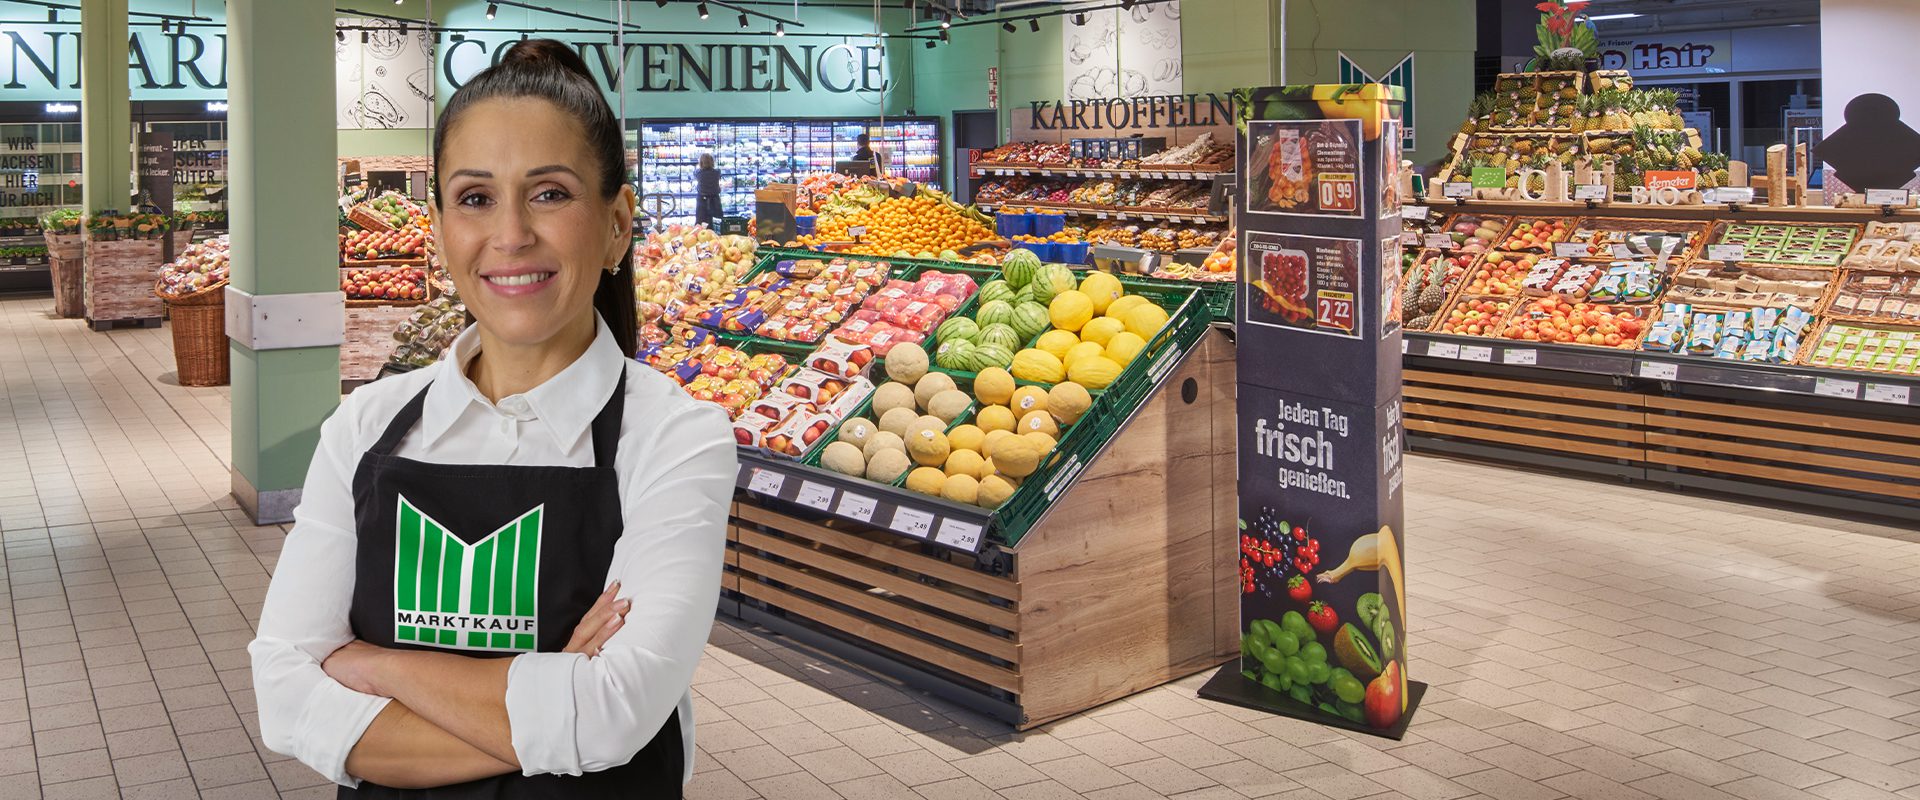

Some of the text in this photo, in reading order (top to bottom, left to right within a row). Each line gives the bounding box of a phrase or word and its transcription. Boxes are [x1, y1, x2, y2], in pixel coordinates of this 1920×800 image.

[443, 39, 889, 93] CVENIENCE
[1633, 43, 1715, 69] Hair
[1030, 91, 1234, 130] KARTOFFELN
[8, 137, 34, 150] WIR
[0, 155, 54, 169] ACHSEN
[174, 151, 212, 166] ISCHE
[6, 174, 37, 188] HIER
[173, 168, 215, 184] ÄUTER
[1645, 175, 1690, 189] demeter
[0, 191, 53, 207] ÜR DICH
[1630, 185, 1681, 206] BIO
[1279, 399, 1348, 438] Jeden Tag
[1255, 418, 1333, 470] frisch
[1279, 467, 1350, 499] genießen.
[397, 611, 535, 631] MARKTKAUF
